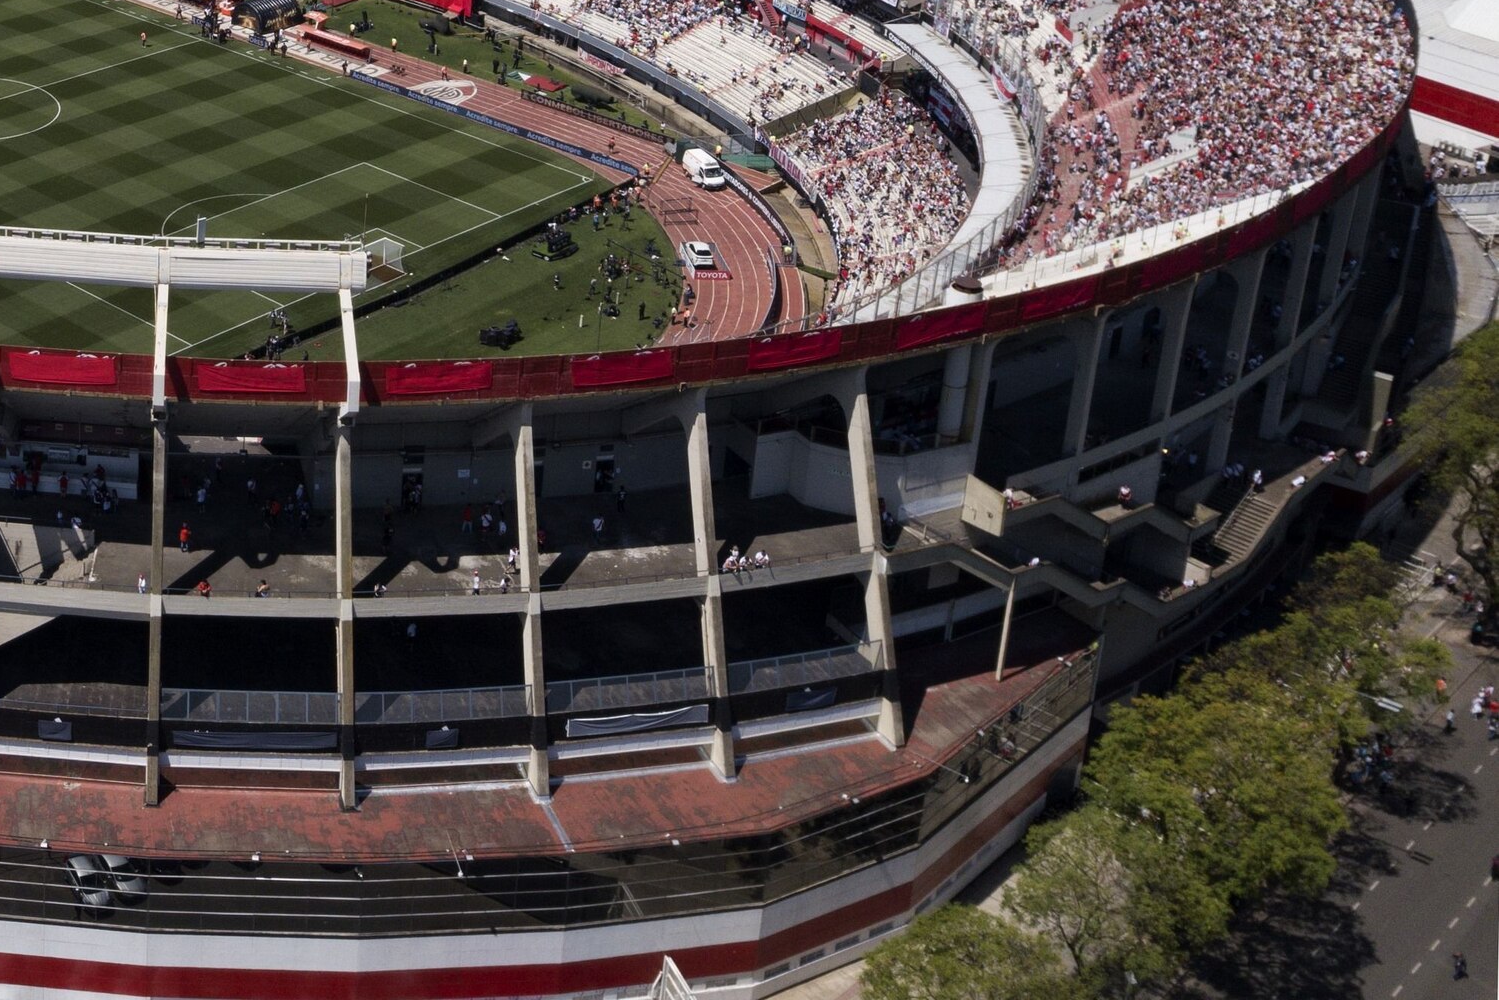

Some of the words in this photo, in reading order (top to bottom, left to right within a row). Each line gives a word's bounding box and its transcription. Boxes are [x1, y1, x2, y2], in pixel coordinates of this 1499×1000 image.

[352, 71, 380, 85] Acredite
[407, 90, 433, 104] Acredite
[466, 110, 493, 125] Acredite
[530, 92, 586, 119] CONMEBOL
[585, 111, 663, 144] LIBERTADORES
[527, 131, 555, 147] Acredite
[591, 153, 620, 169] Acredite
[696, 271, 729, 280] TOYOTA
